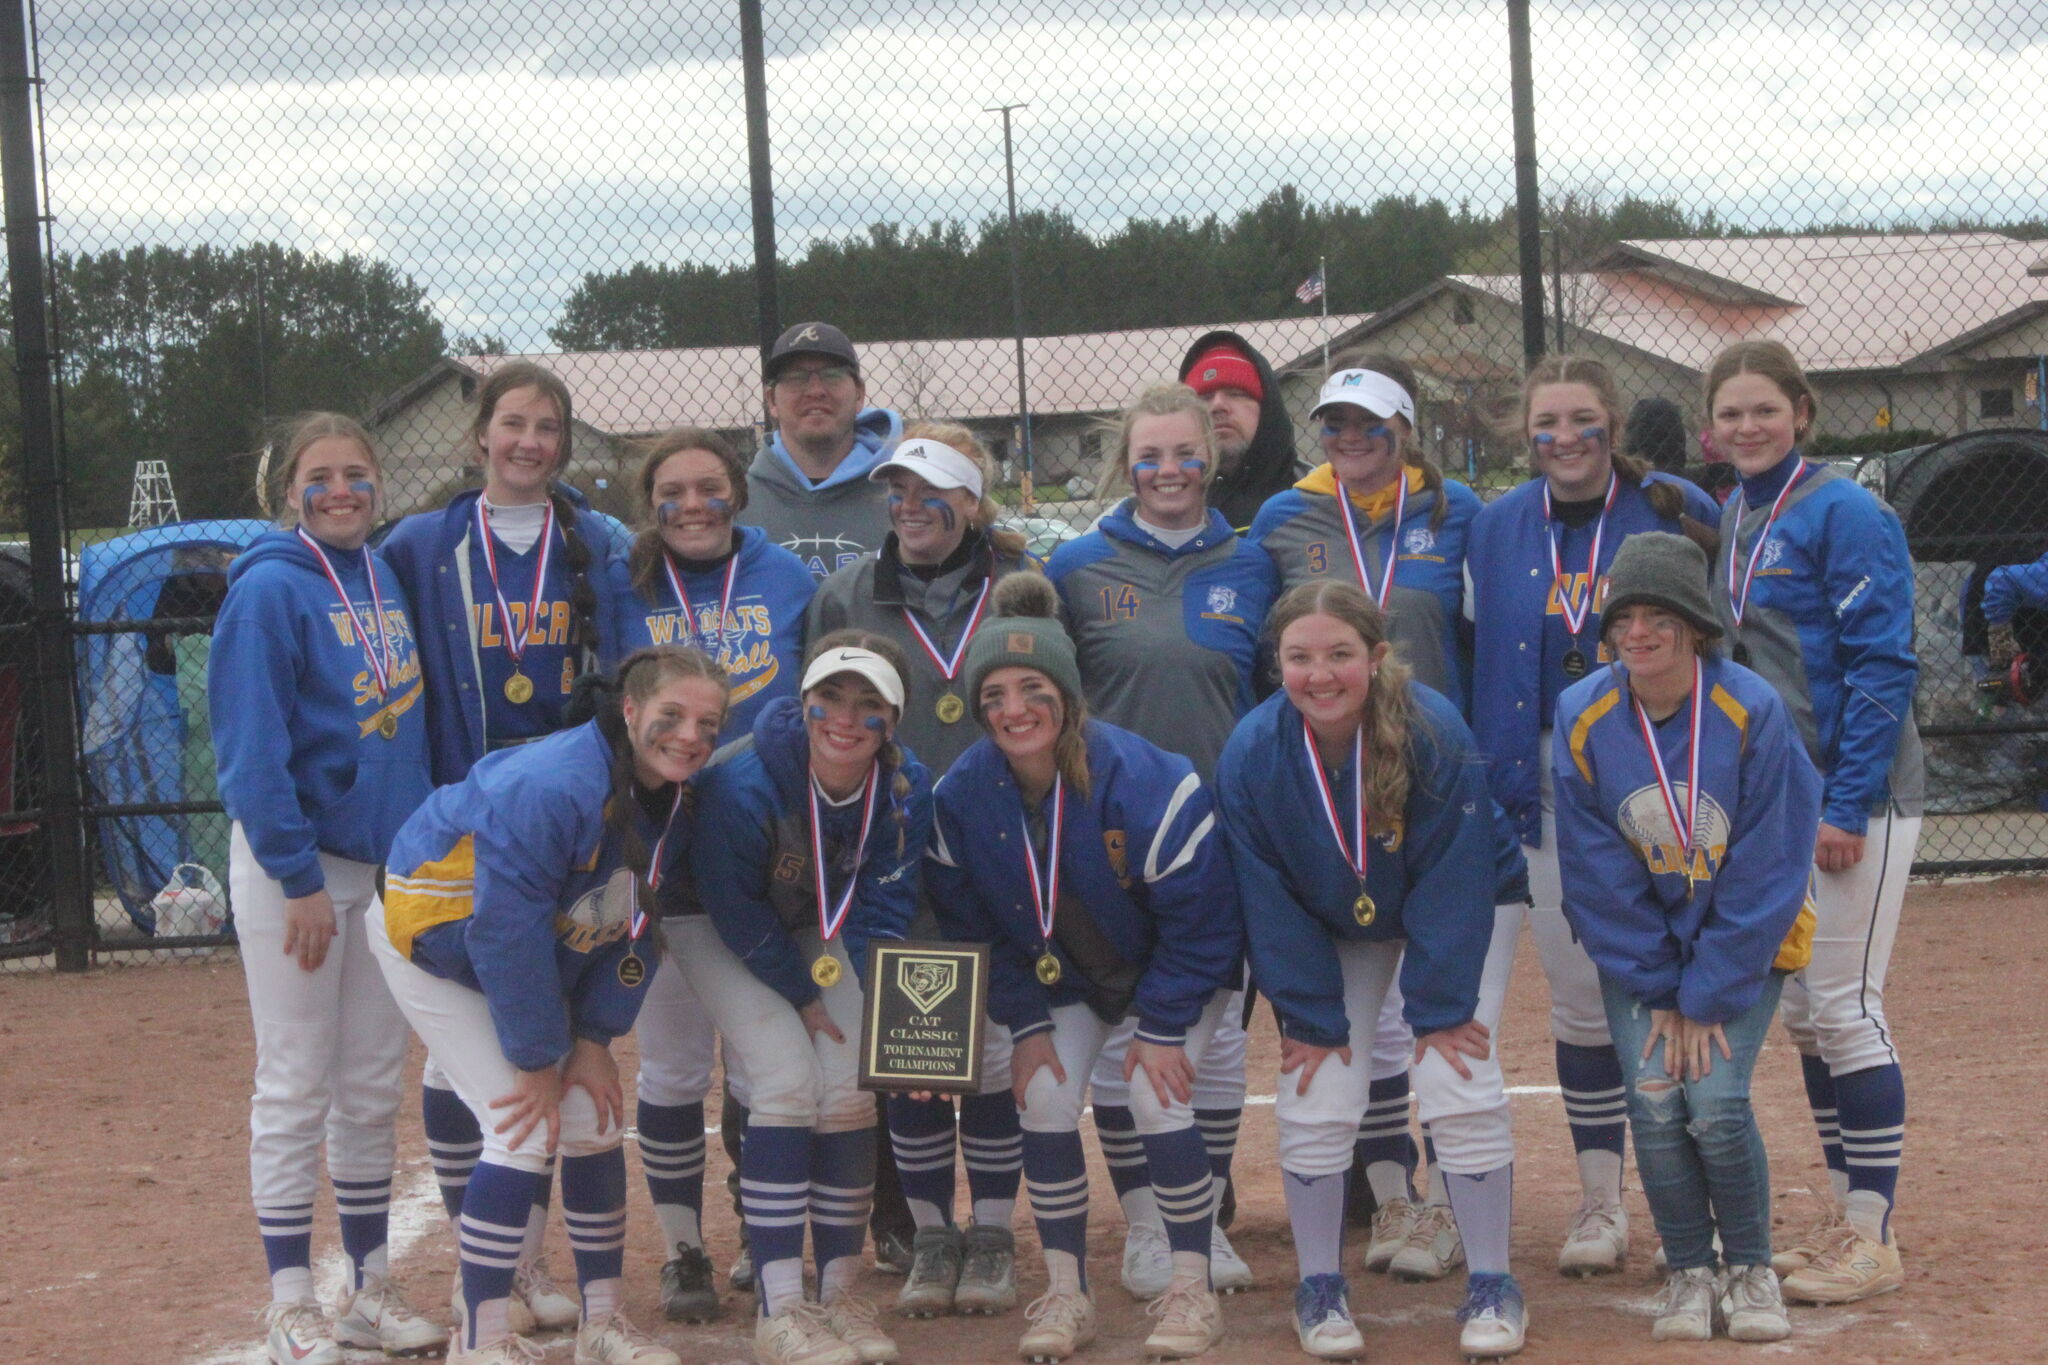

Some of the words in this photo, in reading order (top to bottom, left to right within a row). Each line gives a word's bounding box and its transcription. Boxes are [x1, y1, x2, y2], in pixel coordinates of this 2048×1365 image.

[1305, 541, 1328, 575] 3
[1100, 584, 1141, 622] 14
[774, 853, 805, 884] 5
[908, 1015, 941, 1027] CAT
[890, 1028, 959, 1042] CLASSIC
[883, 1044, 963, 1059] TOURNAMENT
[889, 1059, 956, 1072] CHAMPIONS
